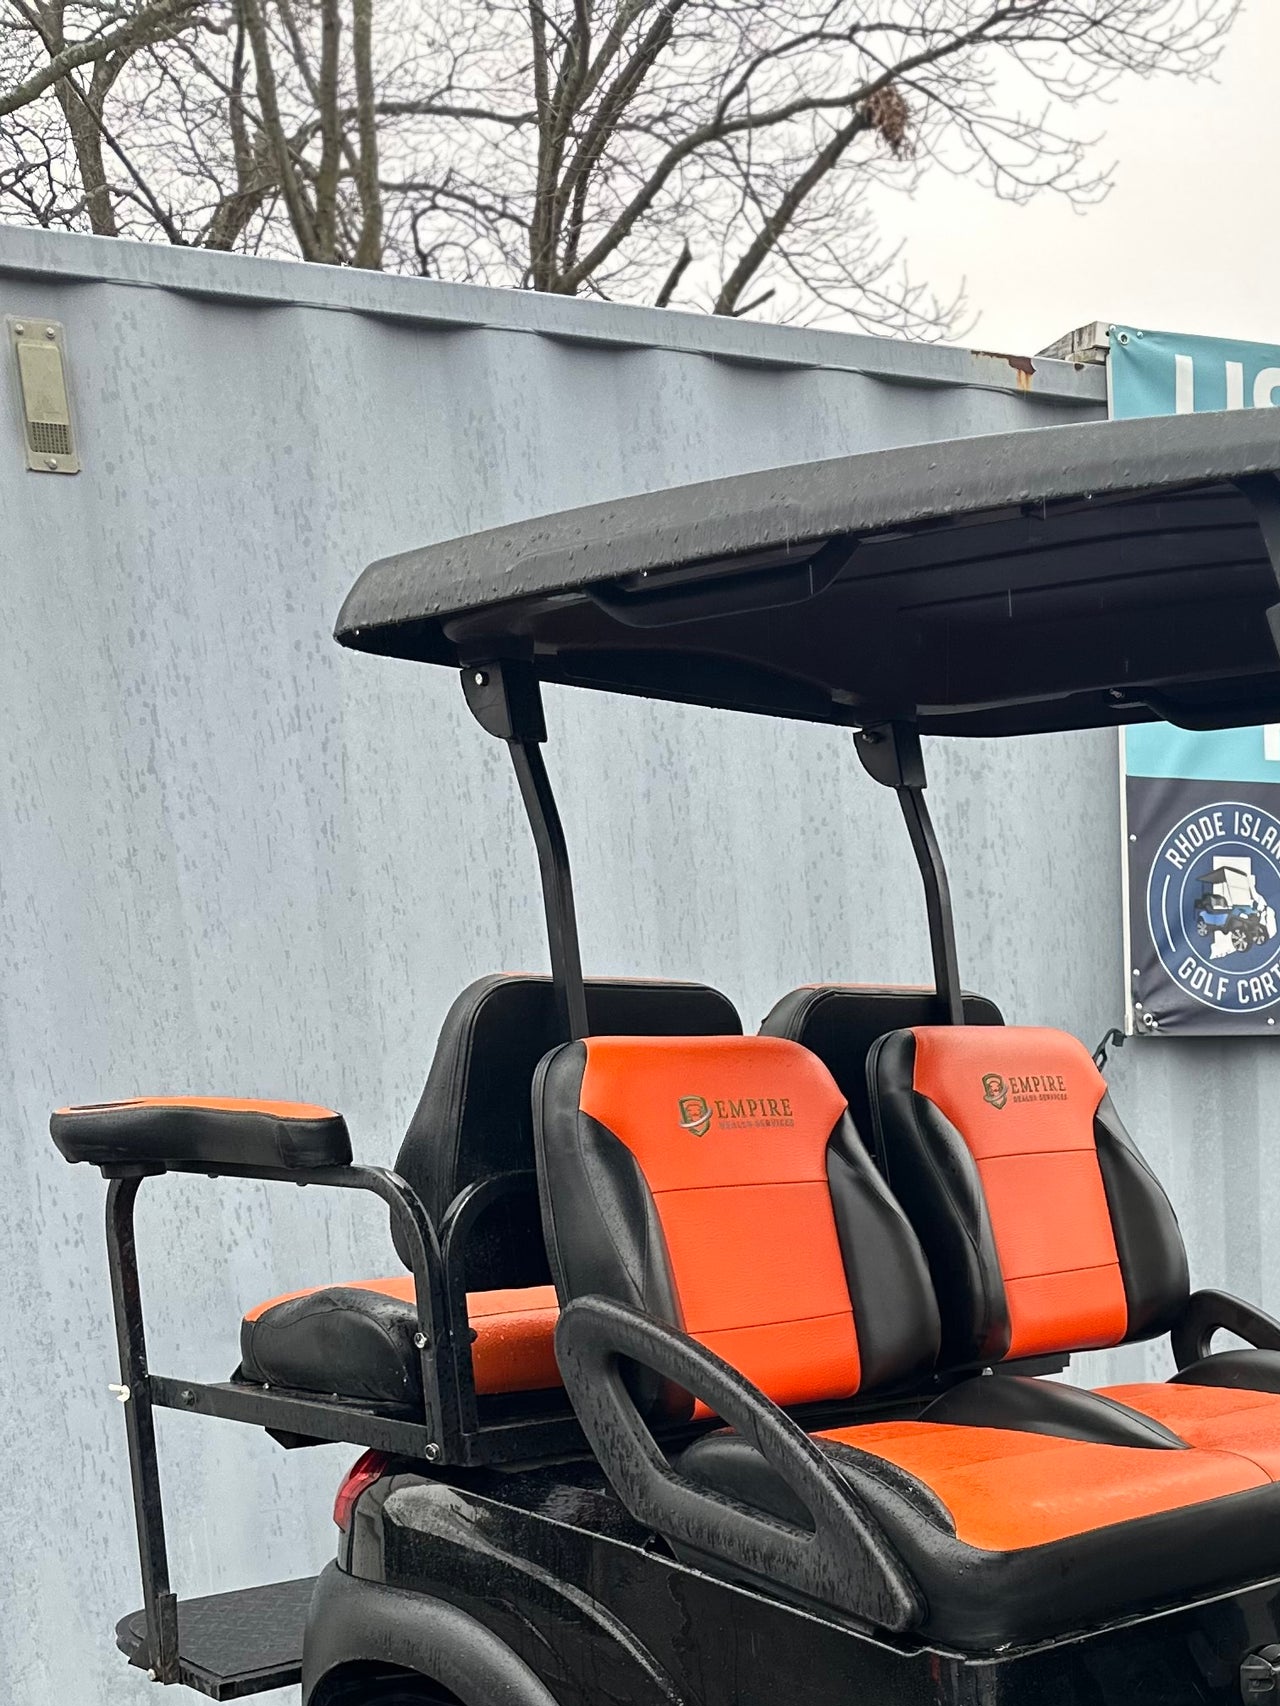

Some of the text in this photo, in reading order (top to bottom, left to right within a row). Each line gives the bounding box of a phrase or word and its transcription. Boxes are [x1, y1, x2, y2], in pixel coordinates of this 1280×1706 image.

[1165, 811, 1226, 871] RHODE
[1178, 956, 1230, 1001] GOLF
[1008, 1075, 1067, 1094] EMPIRE
[714, 1098, 793, 1119] EMPIRE
